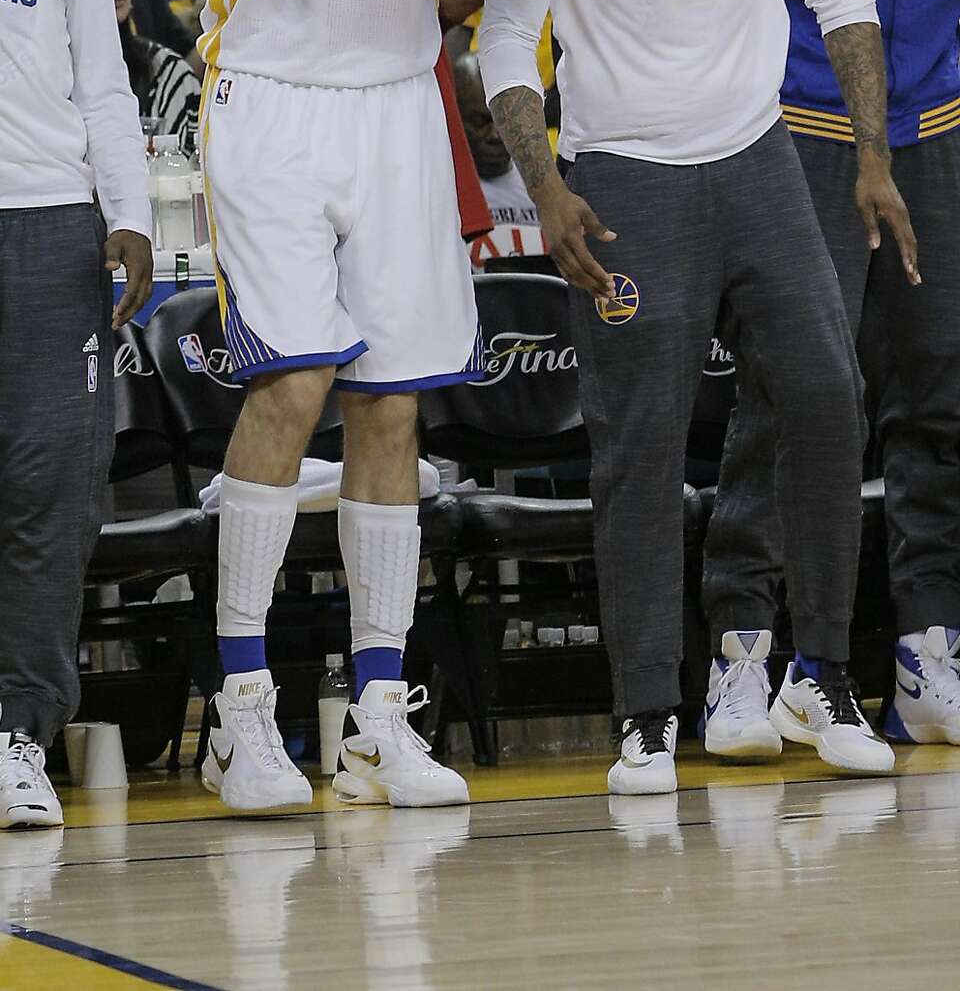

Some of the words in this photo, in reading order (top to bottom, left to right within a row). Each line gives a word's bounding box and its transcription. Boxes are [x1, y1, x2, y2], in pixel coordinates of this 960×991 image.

[467, 332, 580, 387] Fina
[237, 681, 262, 697] NIKE
[383, 692, 403, 704] NIKE
